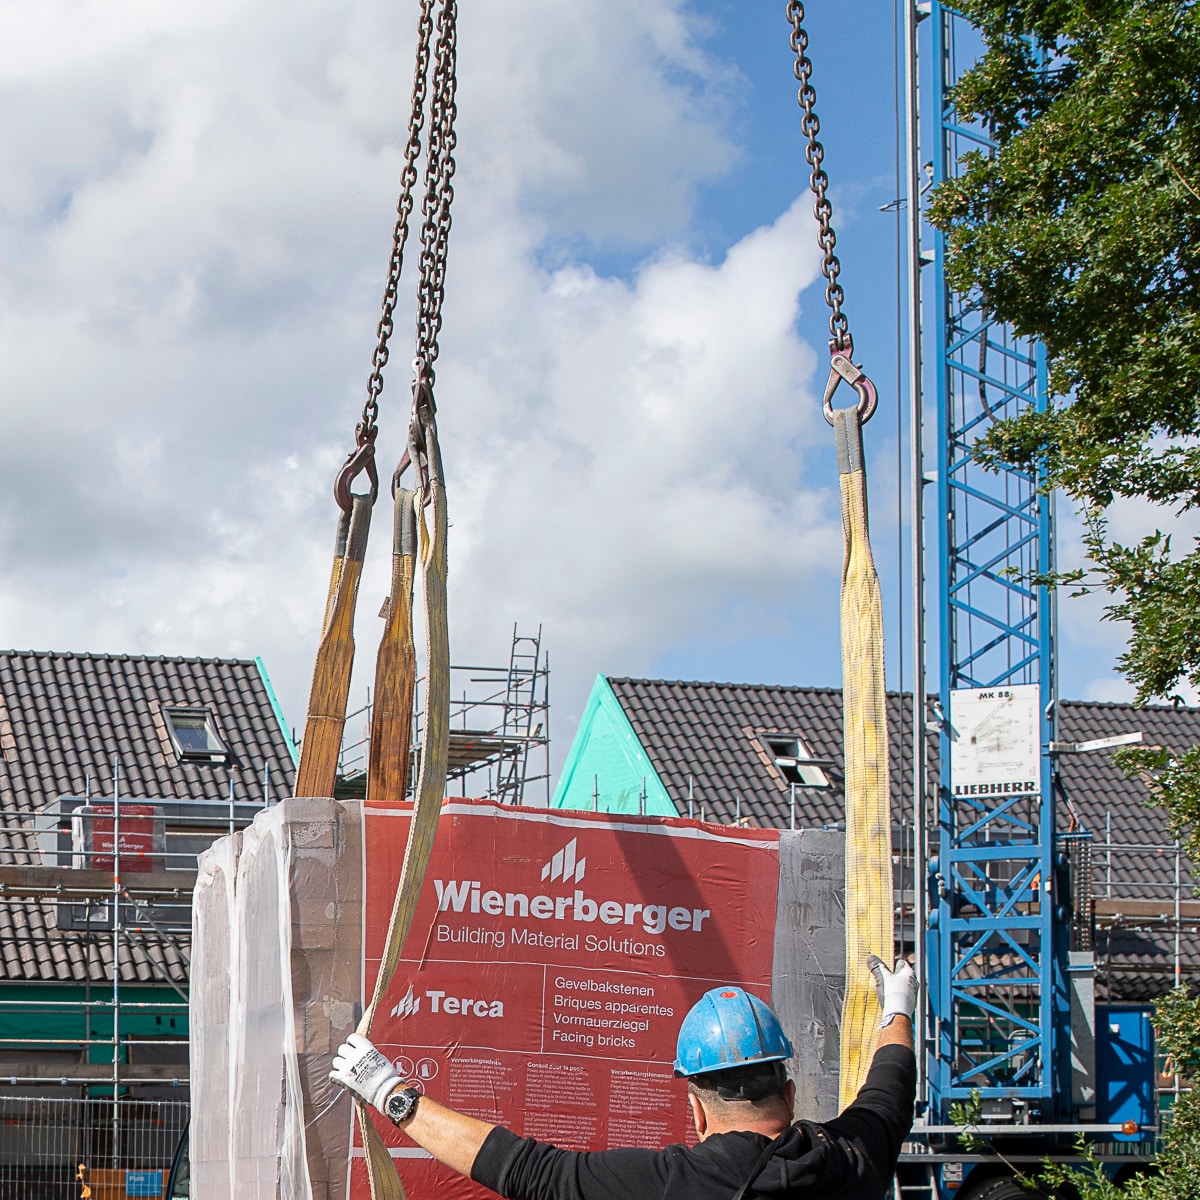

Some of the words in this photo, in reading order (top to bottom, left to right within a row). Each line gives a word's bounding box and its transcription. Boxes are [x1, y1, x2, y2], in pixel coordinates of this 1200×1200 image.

[955, 782, 1036, 796] LIEBHERR
[102, 842, 144, 850] Wierberger
[433, 879, 711, 934] Wienerberger
[437, 925, 505, 948] Building
[510, 927, 578, 950] Material
[584, 934, 666, 957] Solutions
[554, 976, 655, 997] Gevelbakstenen
[426, 990, 504, 1018] Terca
[554, 994, 603, 1014] Briques
[605, 1002, 674, 1021] apparentes
[552, 1012, 650, 1034] Vormauerziegel
[552, 1030, 594, 1049] Facing
[597, 1032, 636, 1048] bricks
